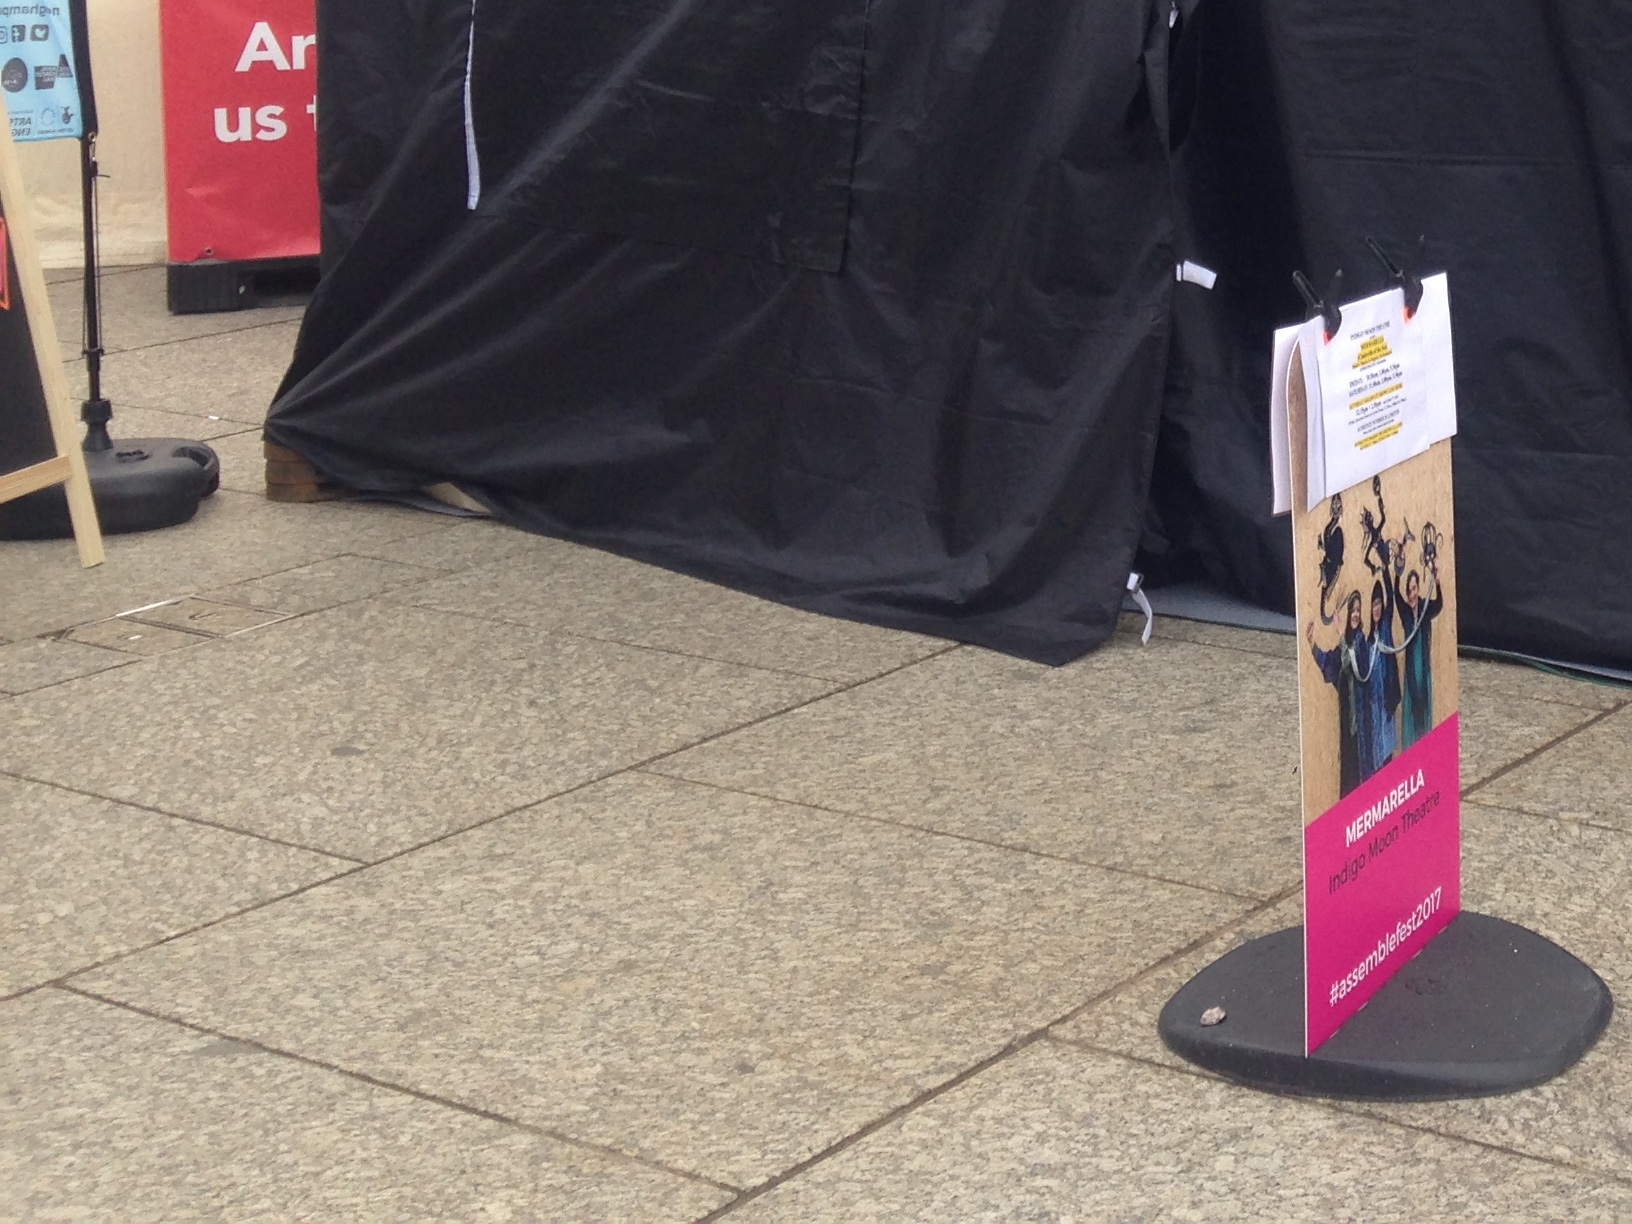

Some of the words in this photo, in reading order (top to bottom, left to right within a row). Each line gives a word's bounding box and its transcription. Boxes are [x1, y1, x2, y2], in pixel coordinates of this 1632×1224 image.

[213, 105, 287, 143] us
[1328, 852, 1366, 894] Indigo
[1368, 825, 1399, 862] Moon
[1401, 790, 1441, 834] Theatre
[1345, 769, 1425, 848] MERMARELLA
[1329, 885, 1442, 1007] #assemblefest2017
